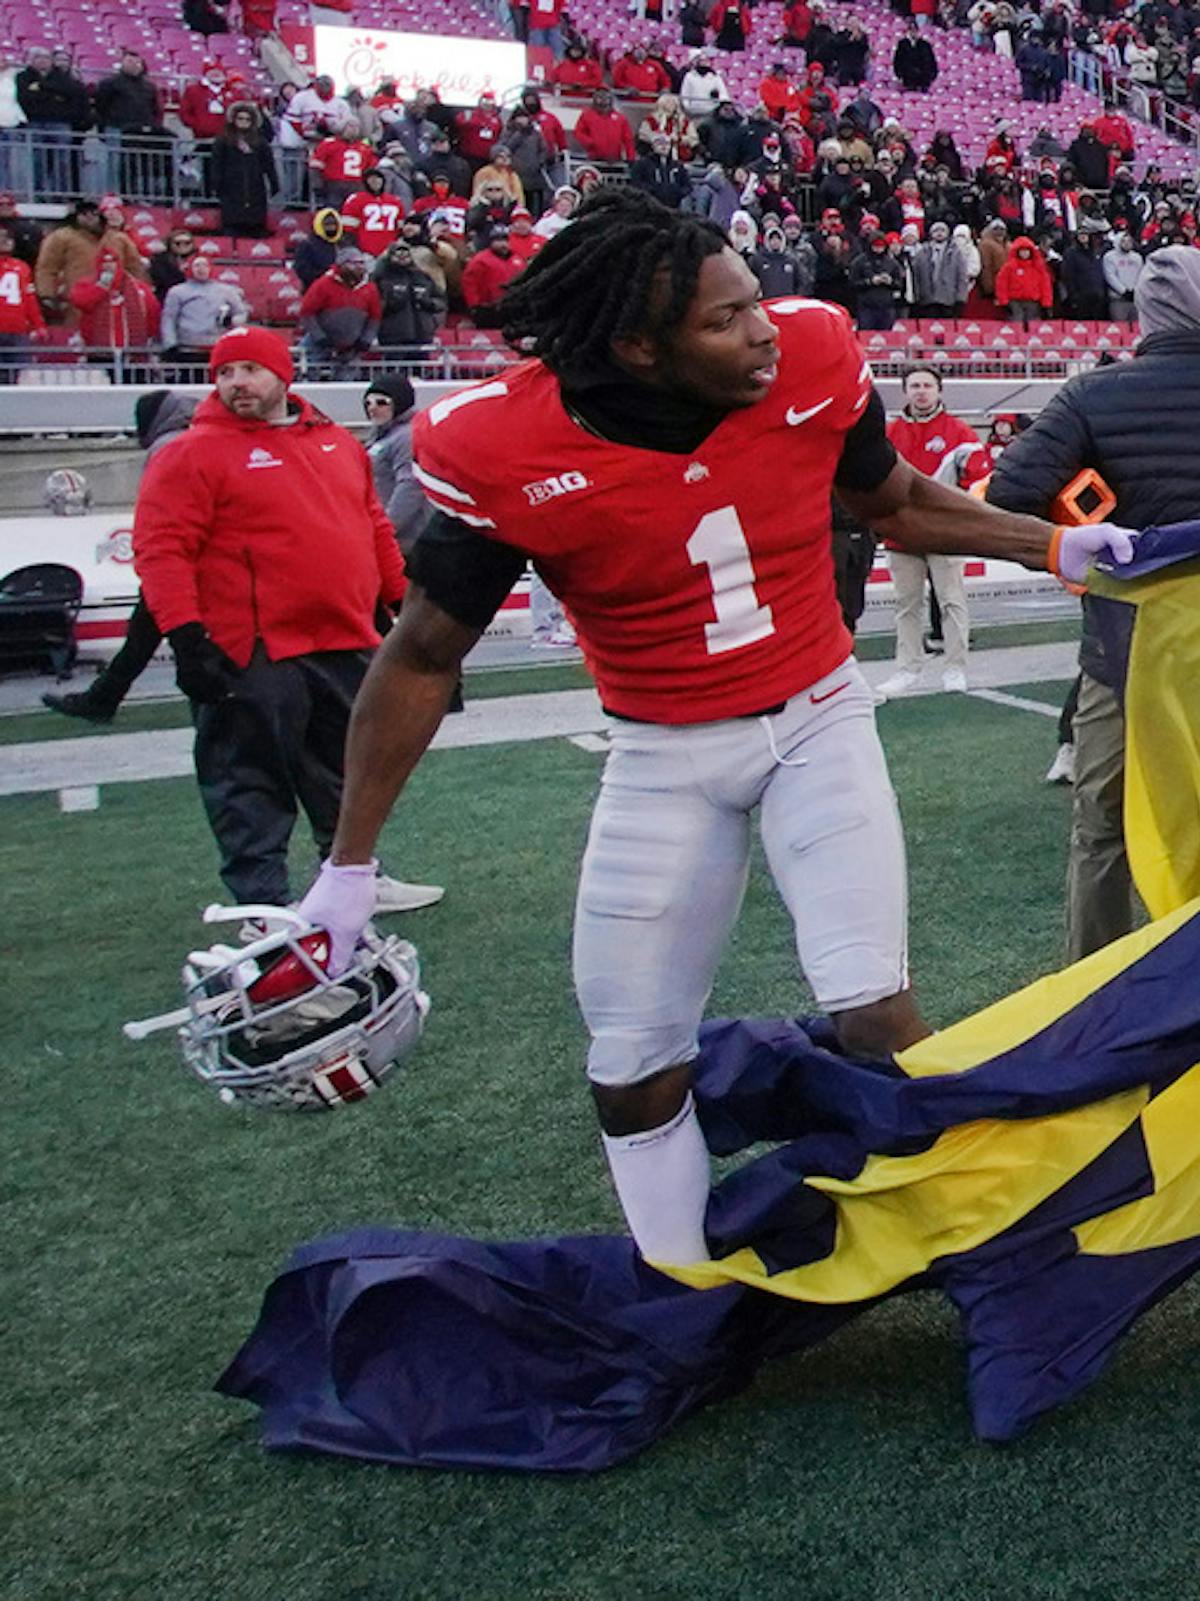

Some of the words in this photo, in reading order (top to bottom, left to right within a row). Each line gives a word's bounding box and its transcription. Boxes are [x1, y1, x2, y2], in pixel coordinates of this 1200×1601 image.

[343, 149, 363, 177] 2
[363, 203, 400, 231] 27
[685, 504, 776, 656] 1
